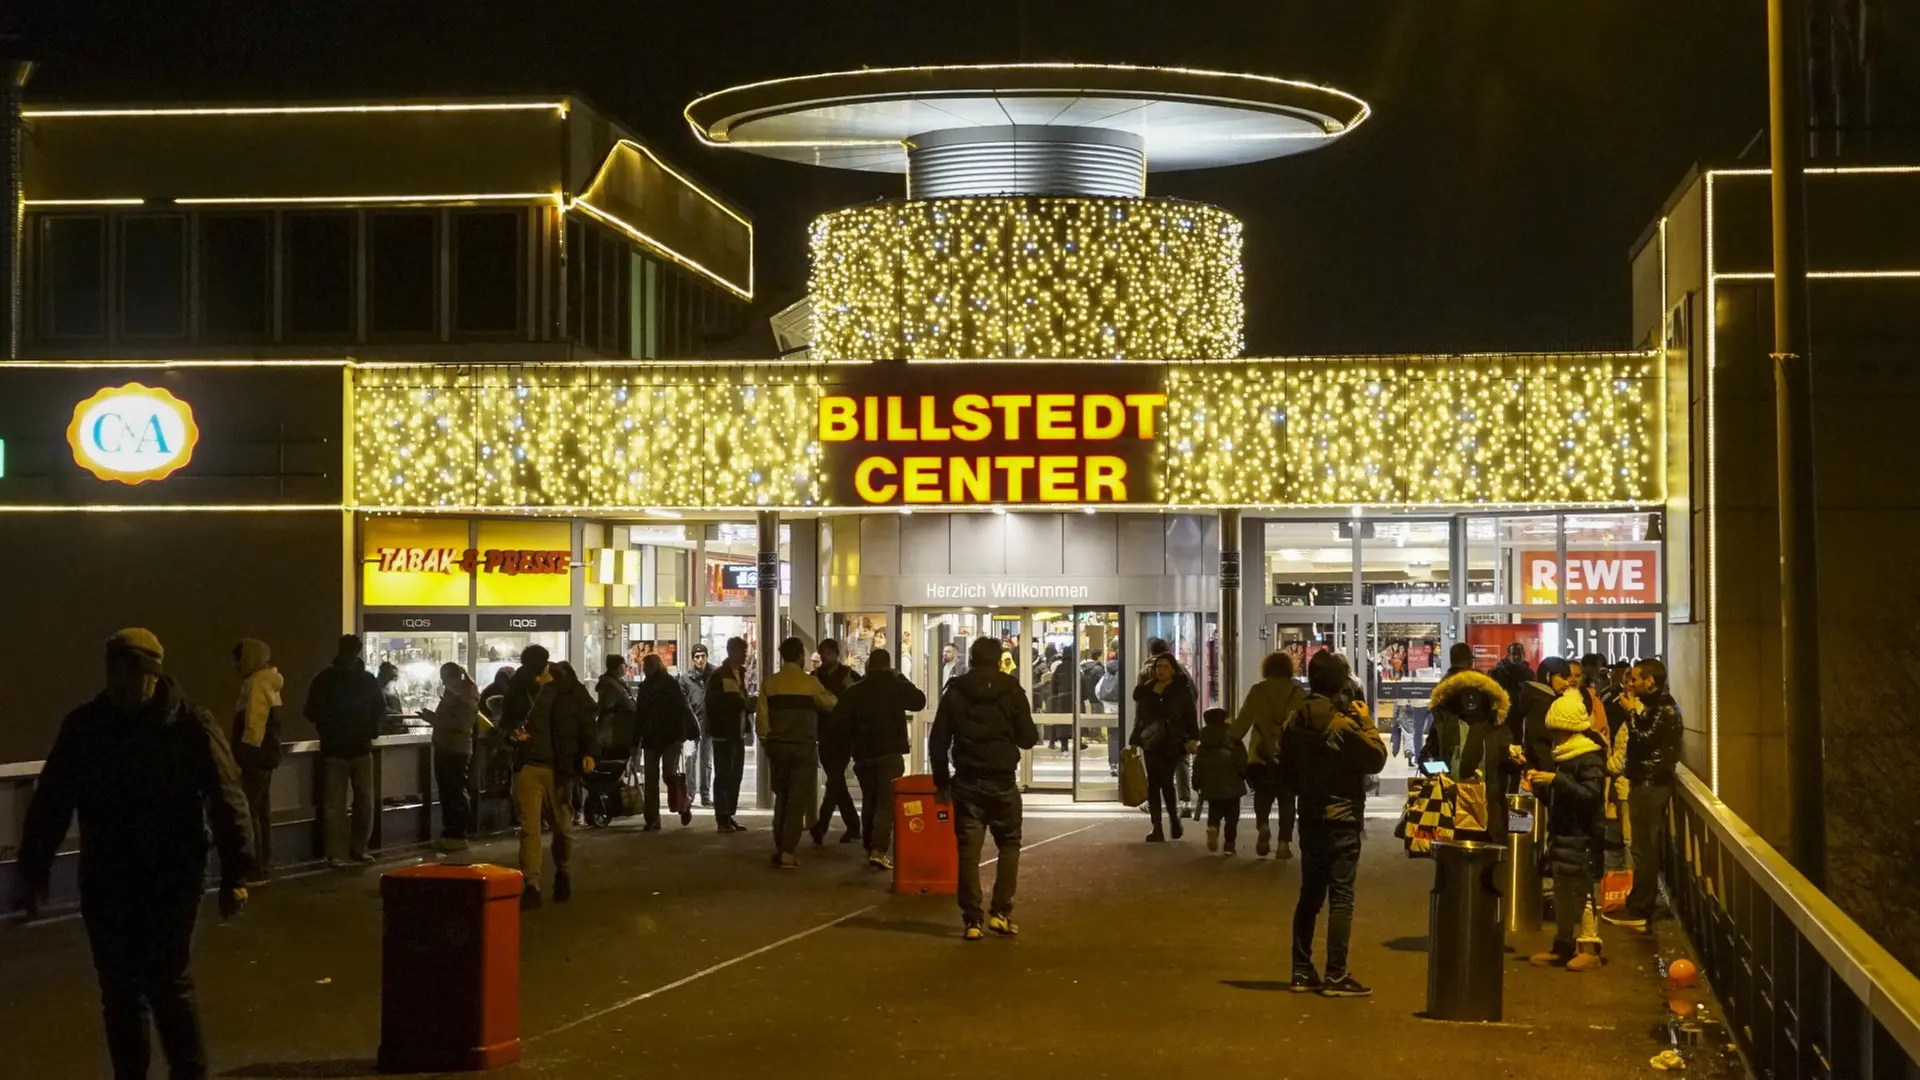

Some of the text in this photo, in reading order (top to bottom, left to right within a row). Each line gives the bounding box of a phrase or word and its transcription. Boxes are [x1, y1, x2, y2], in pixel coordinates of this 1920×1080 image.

[818, 394, 1165, 441] BILLSTEDT
[855, 456, 1128, 503] CENTER
[378, 548, 571, 575] TABAK & PRESSE
[1532, 559, 1645, 590] REWE
[926, 583, 1088, 598] Herzlich Willkommen
[402, 618, 431, 628] IQOS
[509, 618, 537, 628] IQOS
